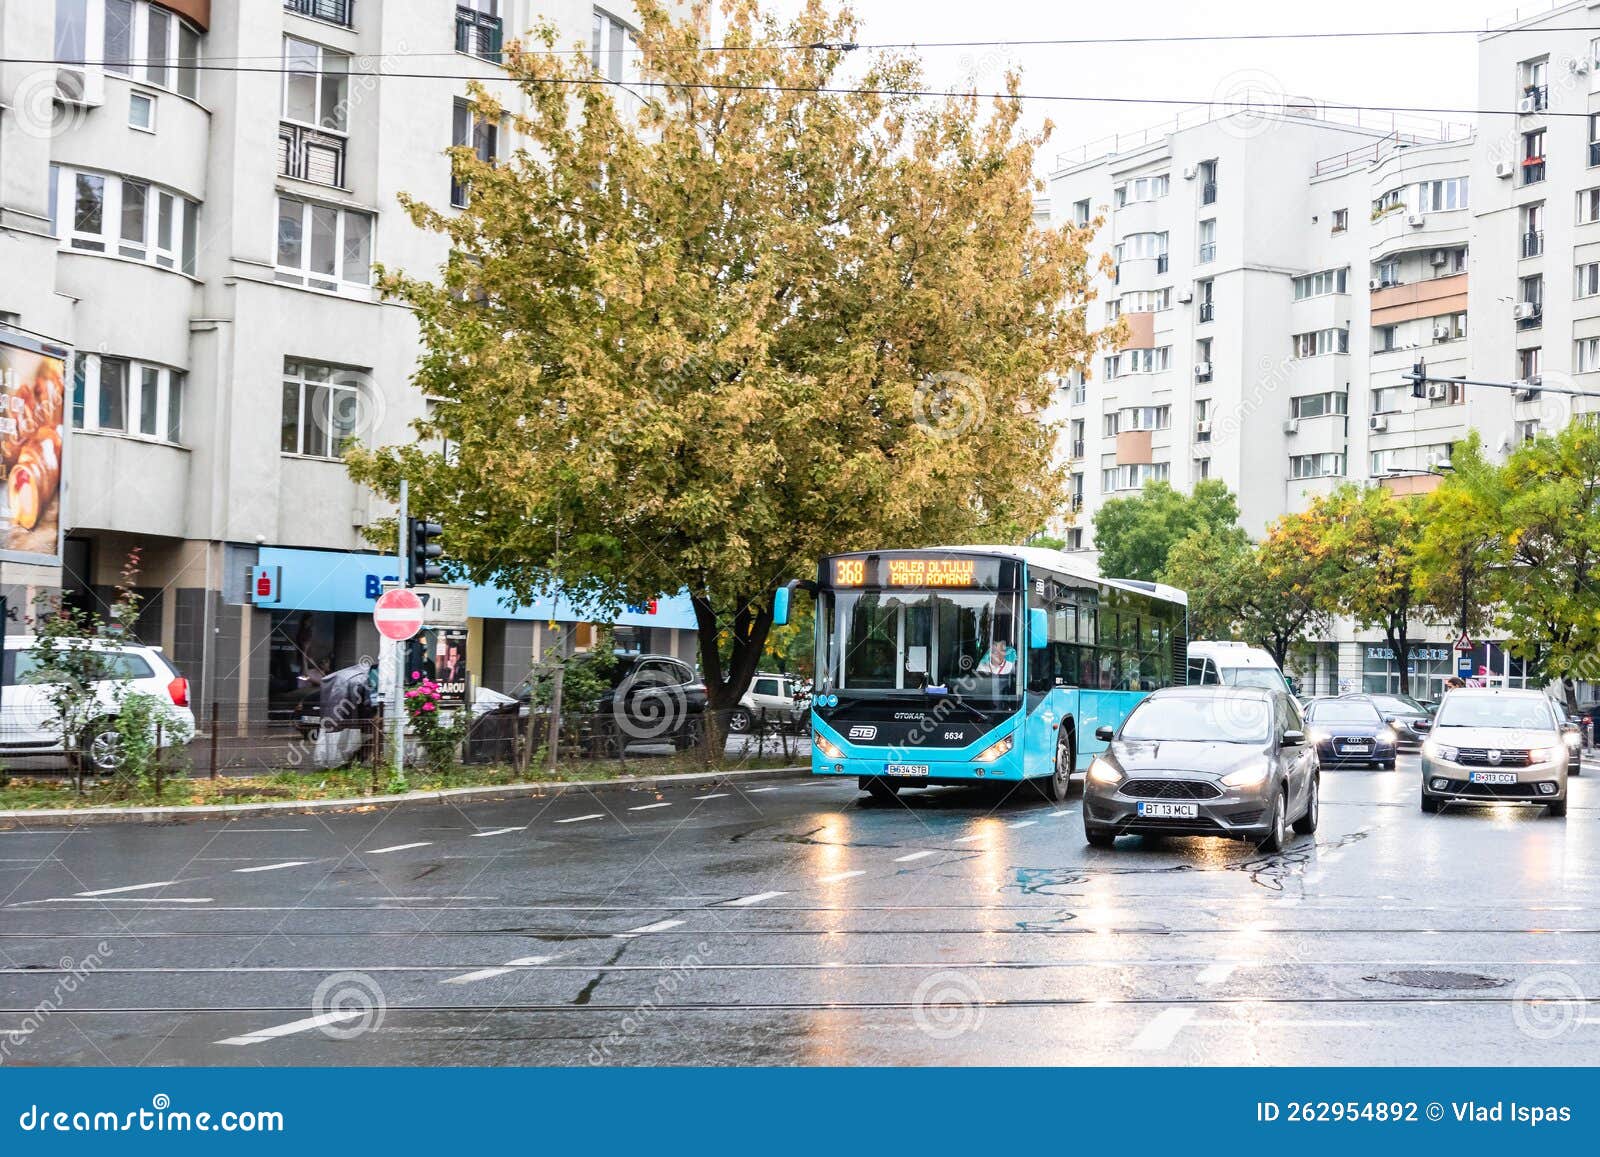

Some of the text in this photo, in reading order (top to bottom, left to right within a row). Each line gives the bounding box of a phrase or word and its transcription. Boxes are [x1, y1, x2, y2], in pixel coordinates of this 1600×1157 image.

[837, 560, 864, 584] 368
[889, 561, 974, 573] VALEA OLTULUI
[891, 572, 971, 585] PIATA ROMANA
[435, 682, 465, 693] GAROU
[894, 712, 925, 720] OTOKAR
[849, 727, 875, 738] STB
[944, 731, 964, 740] 6634
[911, 766, 928, 774] STB
[1145, 804, 1194, 816] BT 13 MCL
